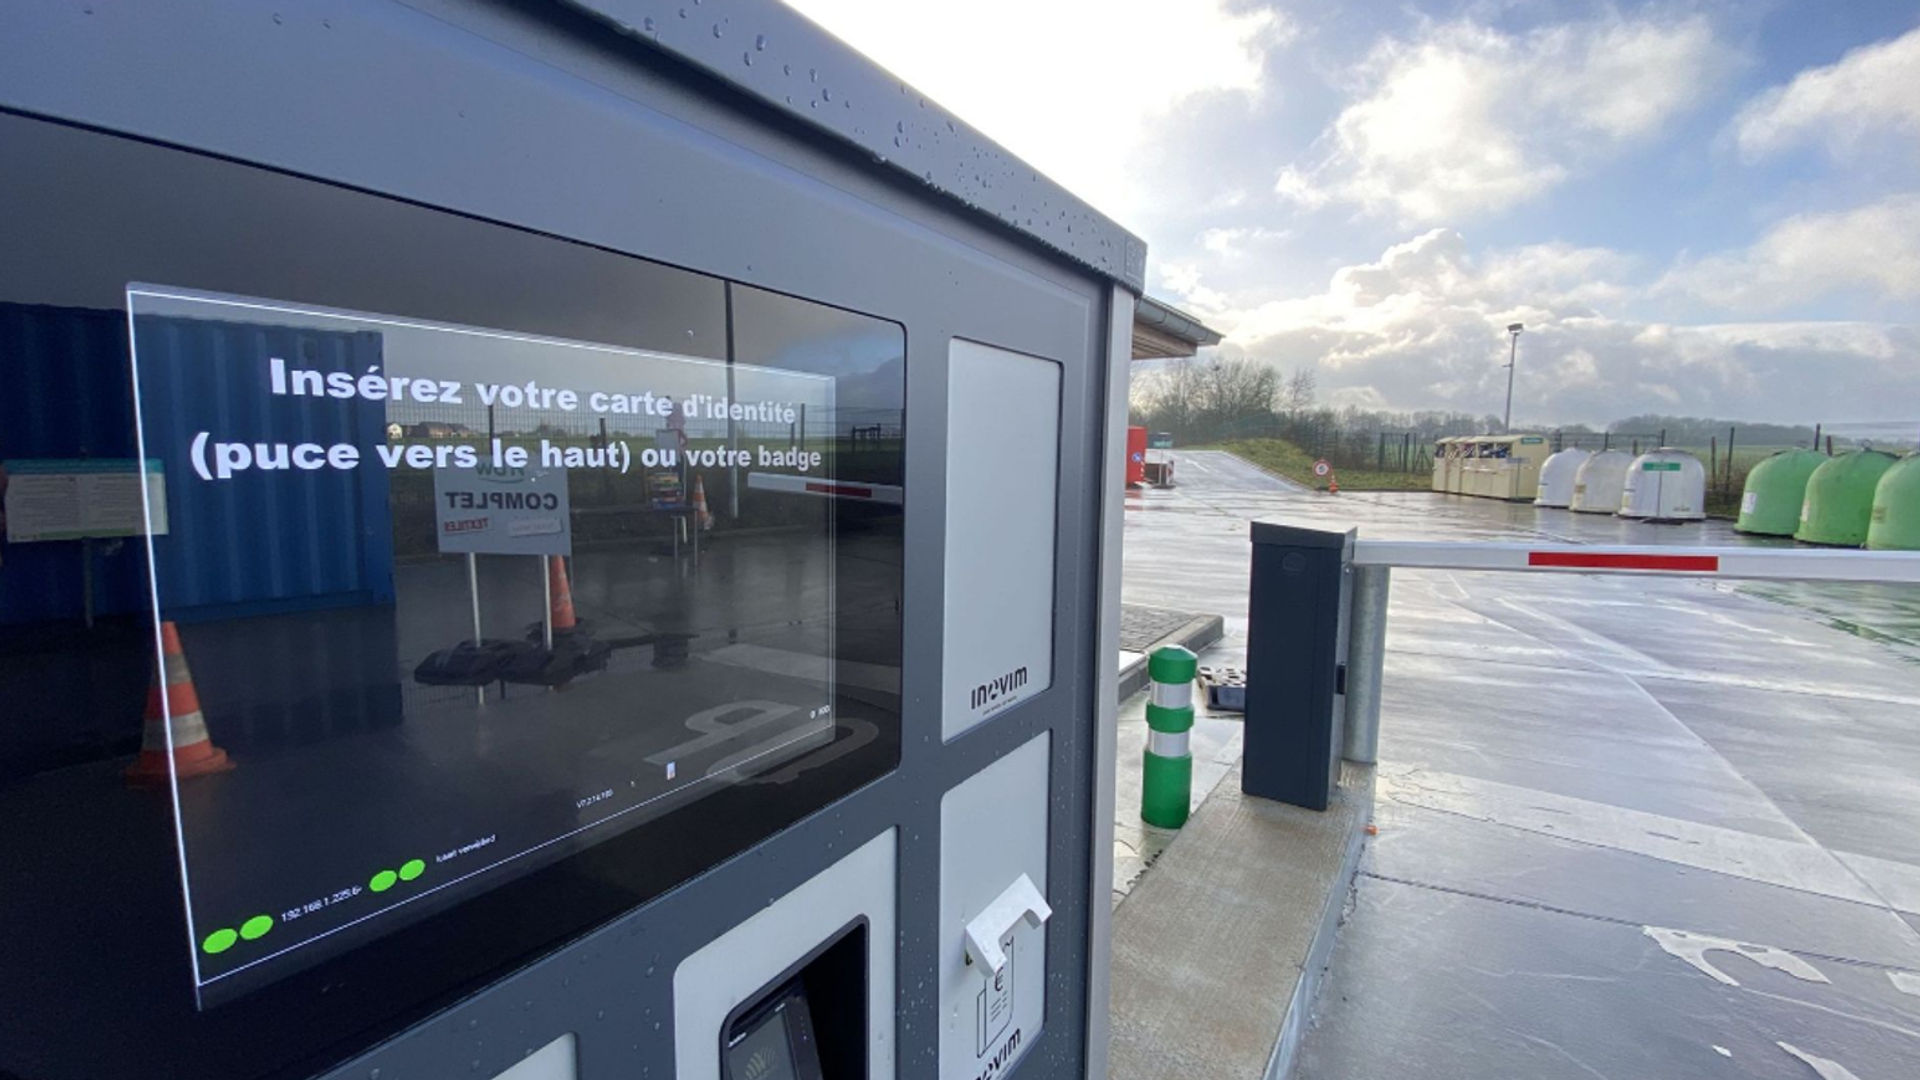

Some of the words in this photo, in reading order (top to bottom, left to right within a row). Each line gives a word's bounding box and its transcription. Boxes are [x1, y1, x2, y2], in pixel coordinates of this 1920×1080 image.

[270, 357, 463, 404] Insérez
[475, 380, 579, 410] votre
[589, 390, 674, 417] carte
[682, 394, 796, 424] d'identité
[190, 431, 361, 481] (puce
[375, 443, 478, 469] vers
[492, 438, 528, 468] le
[541, 439, 631, 474] haut)
[641, 448, 677, 468] ou
[686, 445, 752, 468] votre
[757, 444, 822, 472] badge
